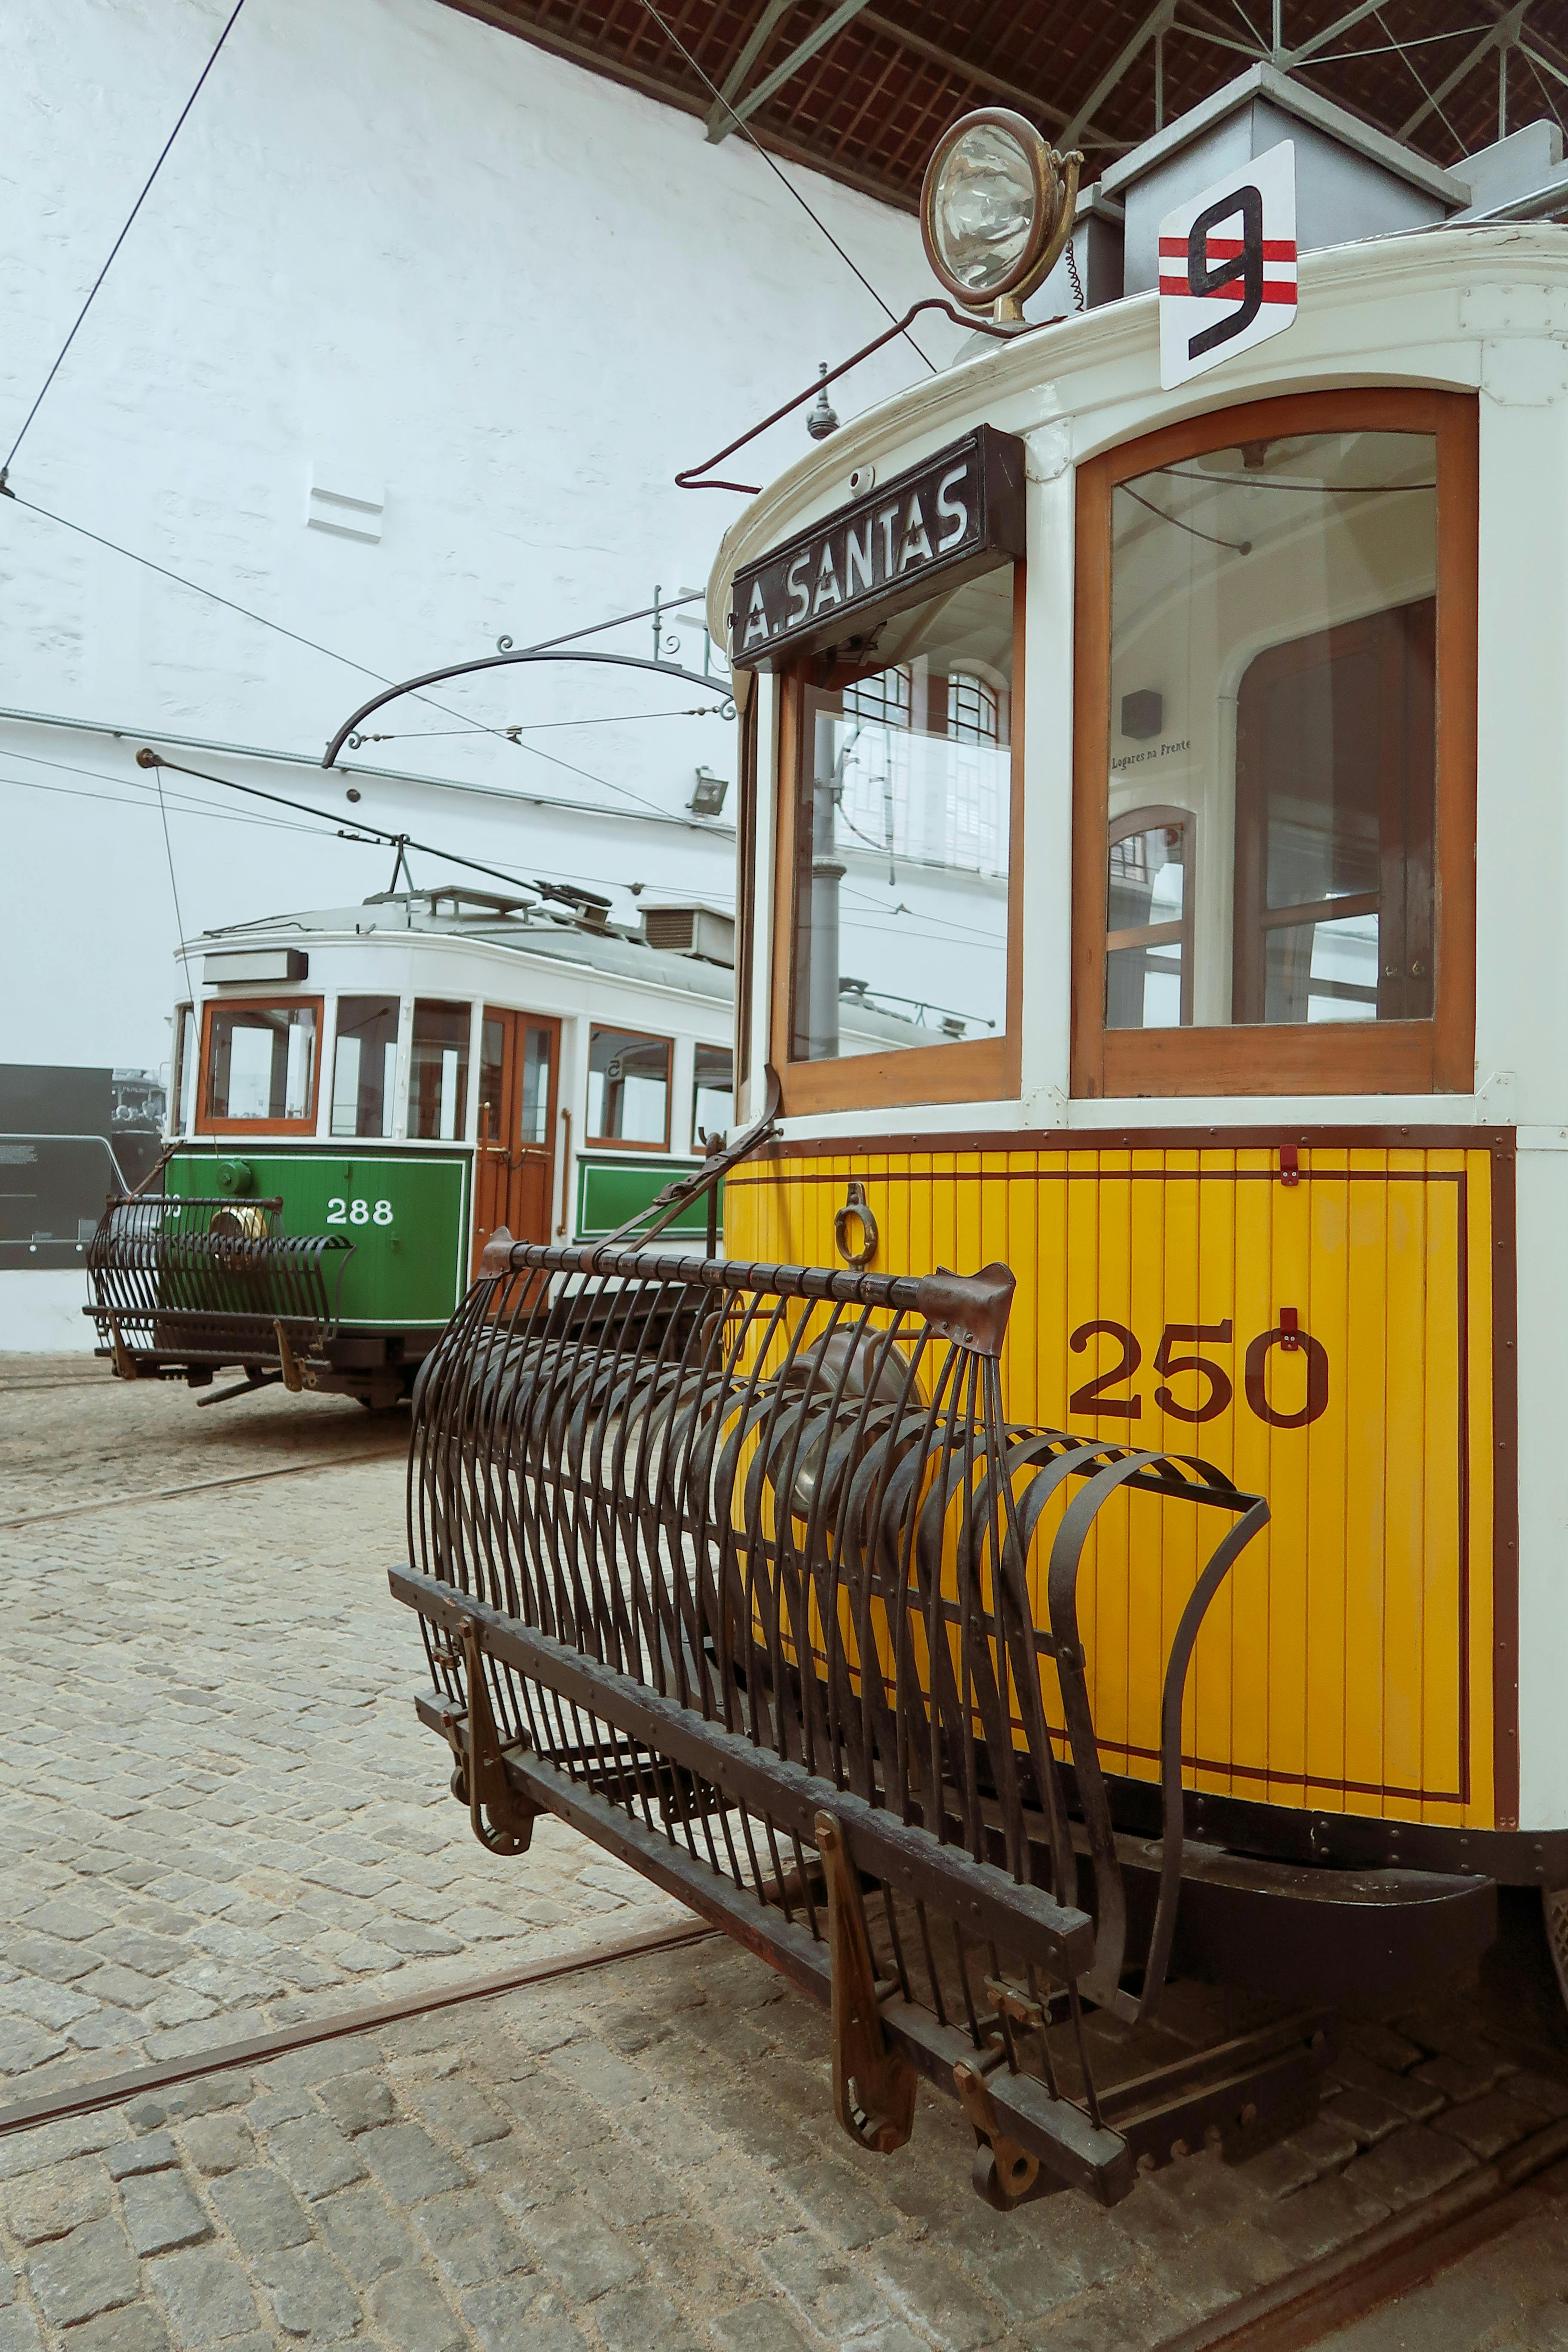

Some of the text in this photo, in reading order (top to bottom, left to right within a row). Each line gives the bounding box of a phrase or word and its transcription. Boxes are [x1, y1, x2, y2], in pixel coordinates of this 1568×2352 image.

[1188, 186, 1263, 361] 9
[1147, 749, 1157, 760] na
[1161, 740, 1191, 756] Frente
[326, 1197, 393, 1225] 288
[1069, 1319, 1329, 1429] 250
